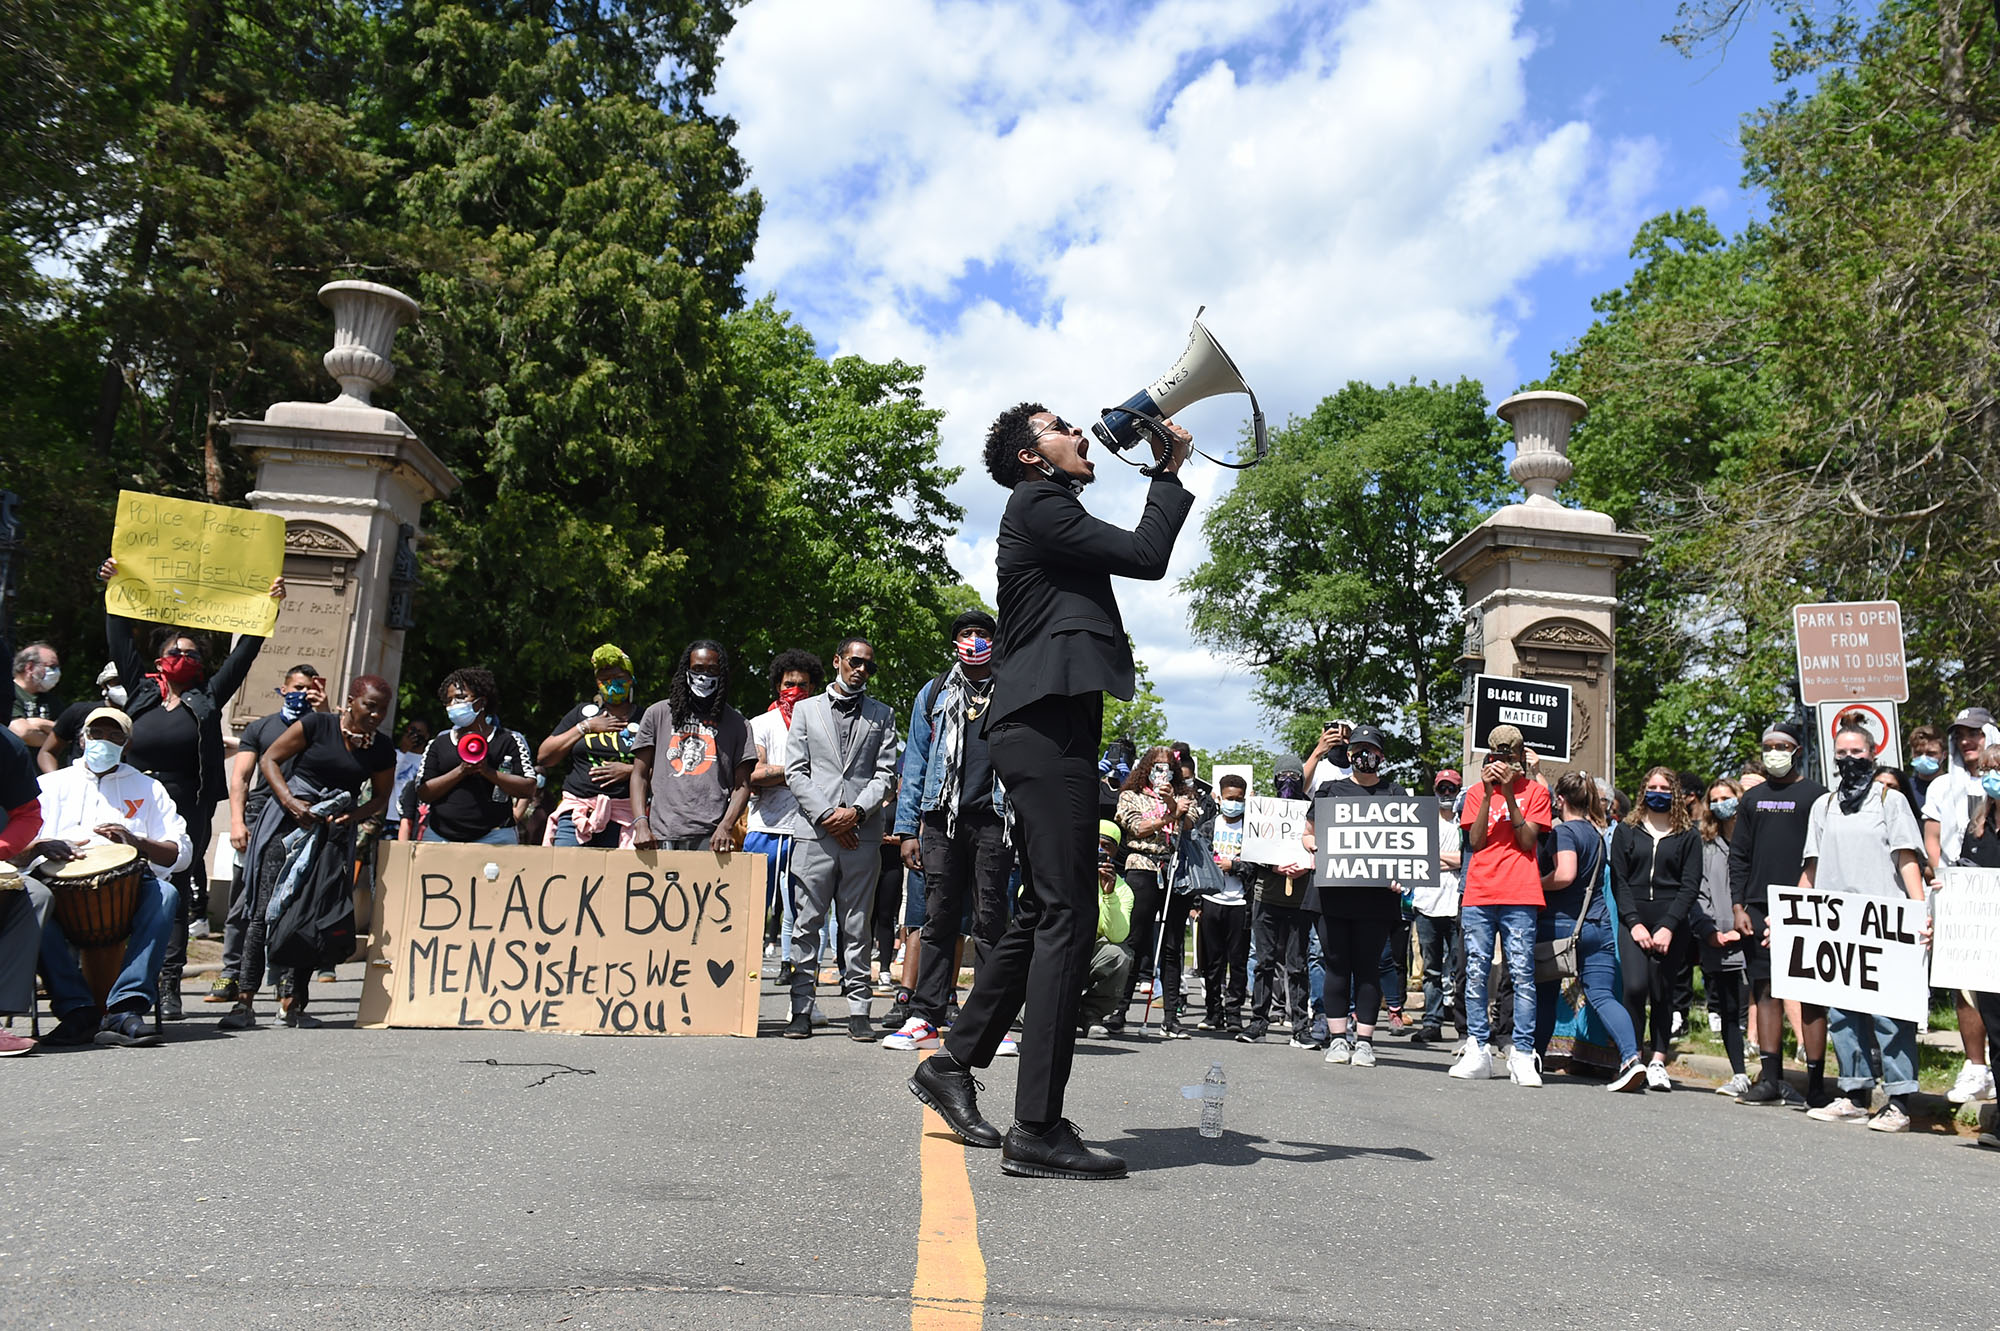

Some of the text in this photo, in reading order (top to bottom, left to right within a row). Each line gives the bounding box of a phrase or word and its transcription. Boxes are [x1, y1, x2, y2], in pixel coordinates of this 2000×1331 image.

[1157, 366, 1189, 397] LIVES
[128, 500, 262, 540] Police Protect
[126, 529, 159, 548] and
[147, 556, 271, 591] THEMSELVES
[117, 585, 149, 610] NOT
[310, 602, 342, 615] PARK
[1800, 610, 1896, 628] PARK IS OPEN
[262, 644, 335, 658] ENRY KENEY
[1831, 633, 1869, 648] FROM
[1803, 653, 1901, 670] DAWN TO DUSK
[1487, 687, 1559, 708] BLACK LIVES
[1503, 709, 1544, 724] MATTER
[1334, 802, 1420, 824] BLACK
[1339, 831, 1416, 850] LIVES
[1325, 858, 1430, 881] MATTER
[1943, 872, 1959, 894] IF
[1965, 873, 1989, 896] YOU
[419, 870, 606, 938] BLACK
[1779, 893, 1915, 945] IT'S ALL
[647, 949, 691, 988] WE
[1788, 936, 1883, 992] LOVE
[458, 997, 564, 1027] LOVE
